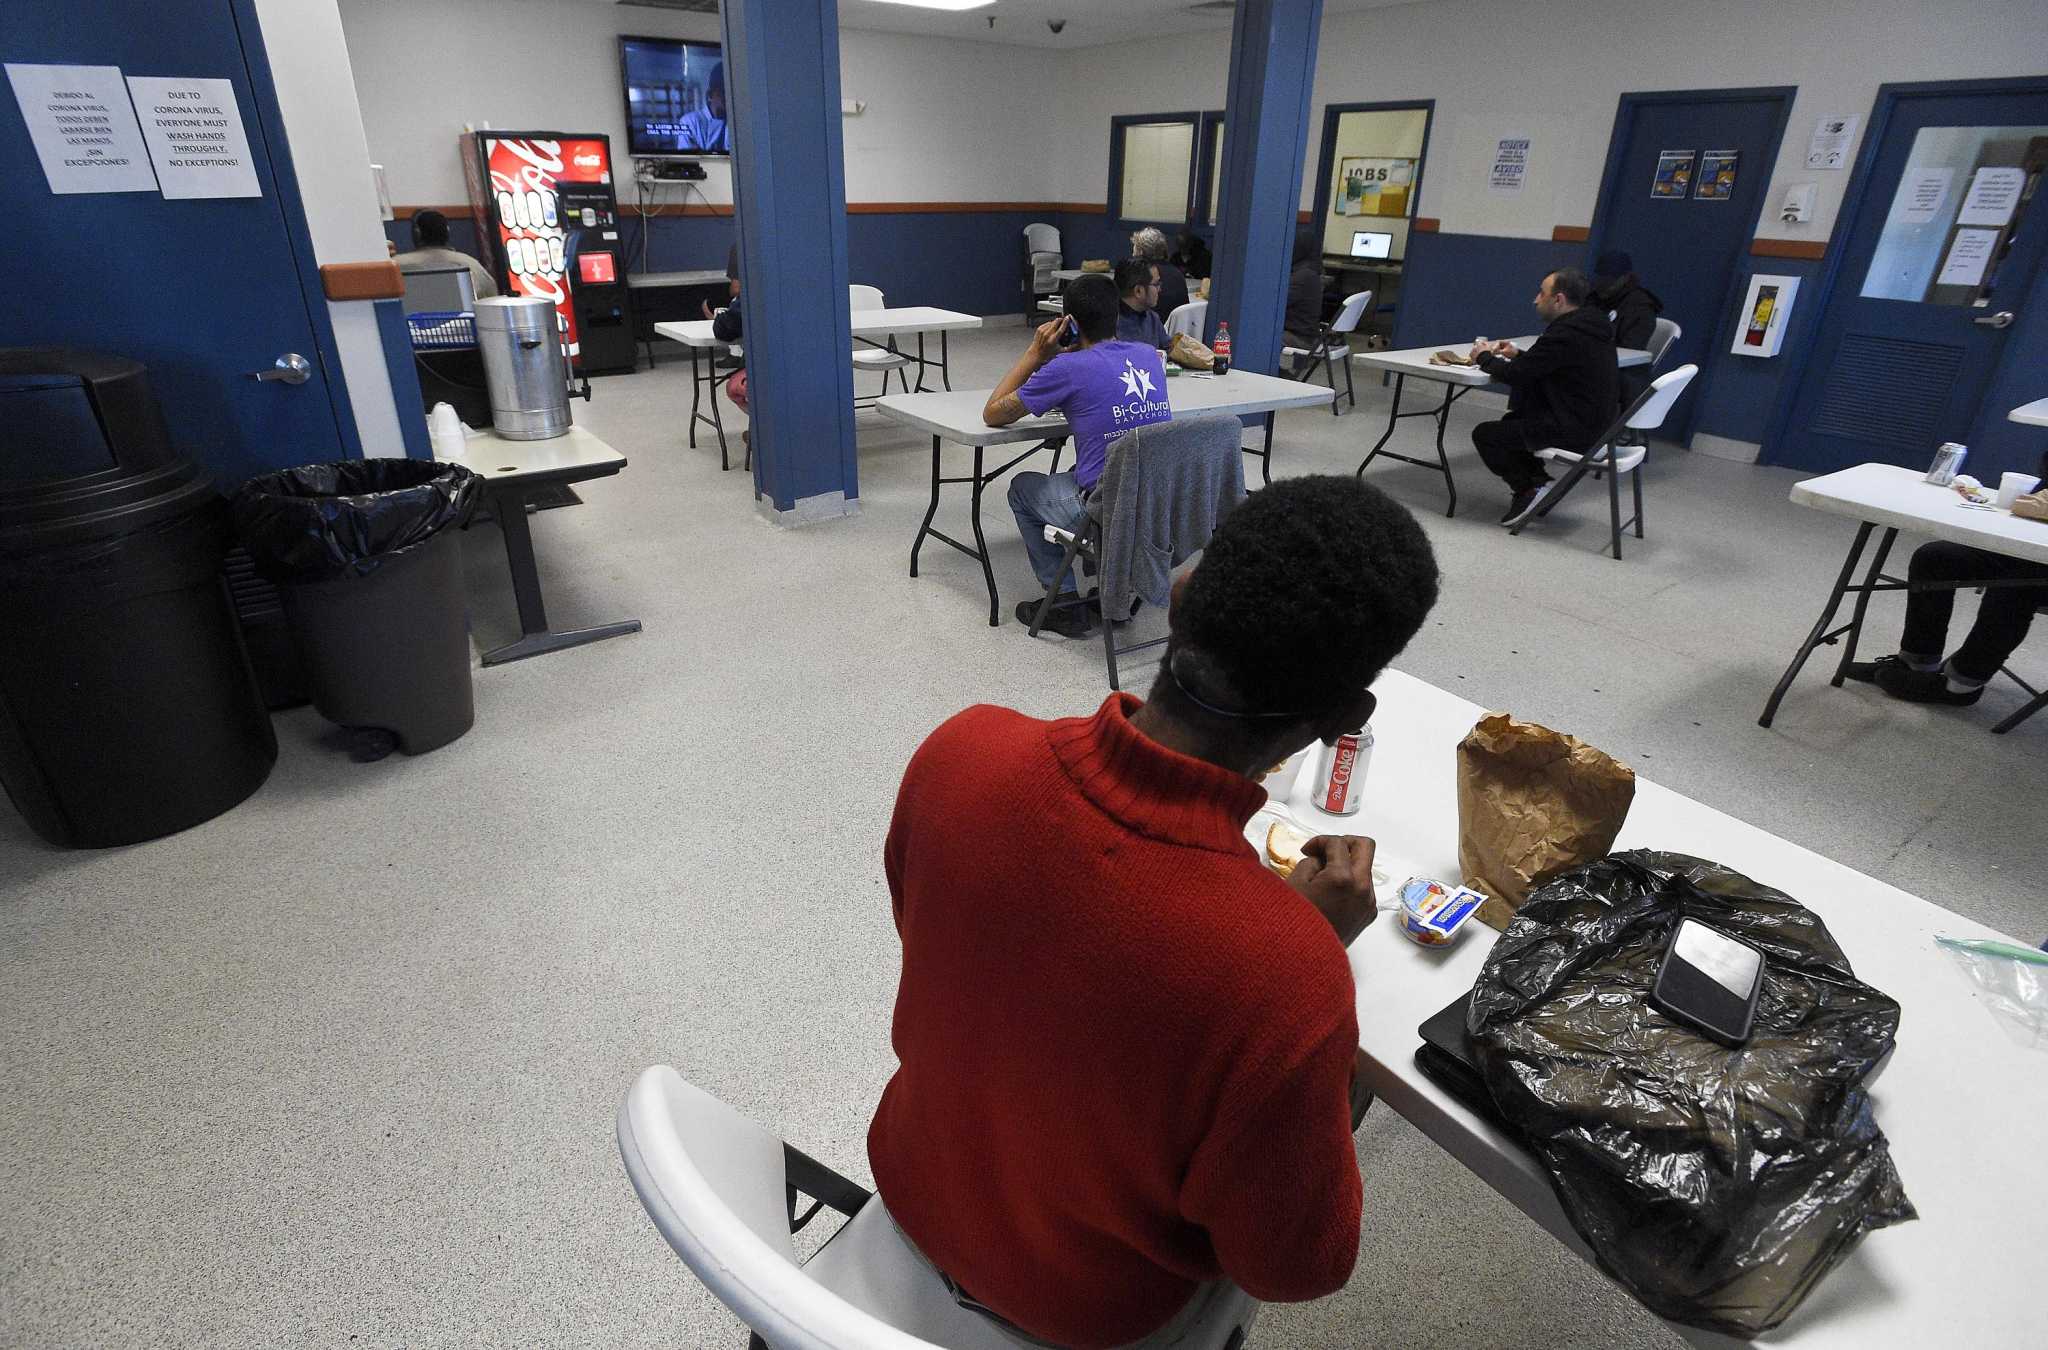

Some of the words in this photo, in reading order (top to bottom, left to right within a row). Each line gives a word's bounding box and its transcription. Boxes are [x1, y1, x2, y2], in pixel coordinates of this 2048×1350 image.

[168, 91, 187, 99] DUE
[188, 91, 201, 99] TO
[154, 106, 193, 114] CORONA
[194, 107, 223, 115] VIRUS,
[155, 119, 202, 127] EVERYONE
[166, 132, 193, 140] WASH
[195, 132, 226, 140] HANDS
[168, 159, 183, 167] NO
[185, 159, 239, 167] EXCEPTIONS!
[1344, 167, 1388, 181] JOBS
[1115, 415, 1135, 425] DAY
[1333, 750, 1354, 785] Coke
